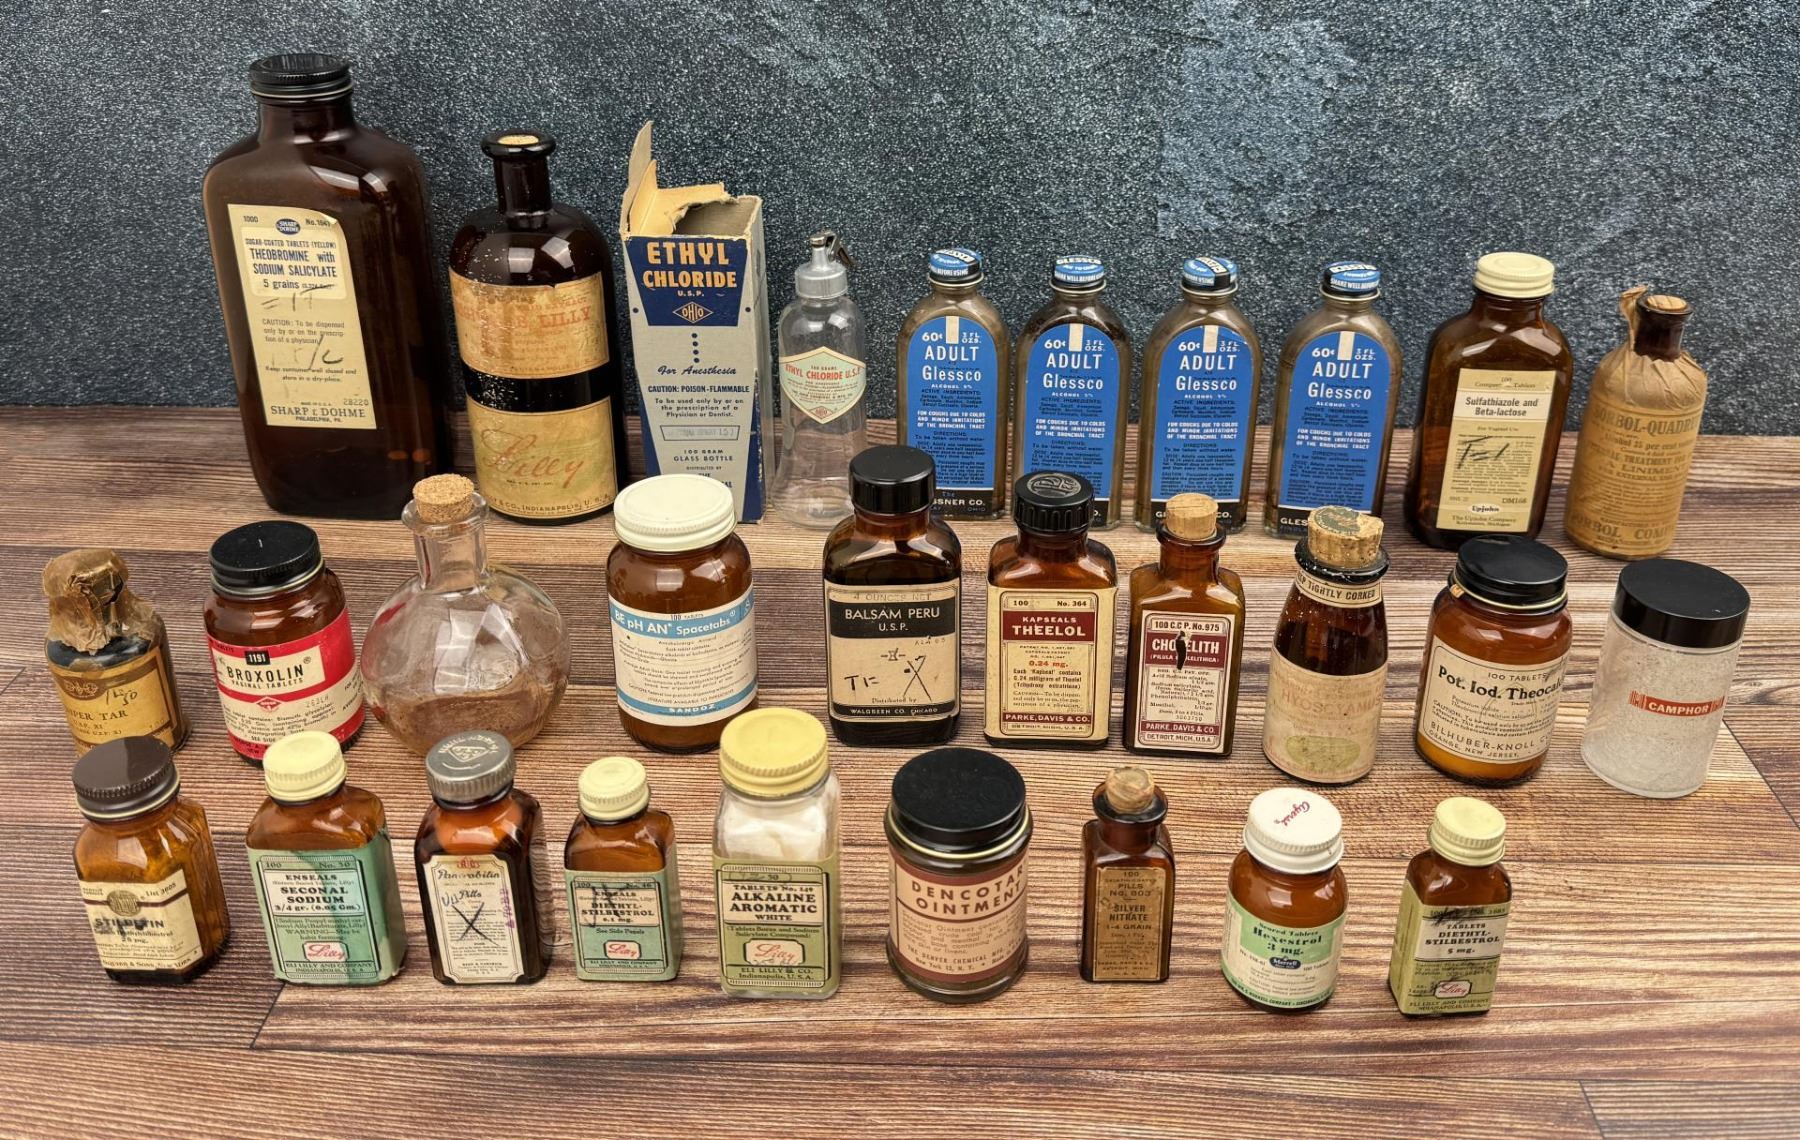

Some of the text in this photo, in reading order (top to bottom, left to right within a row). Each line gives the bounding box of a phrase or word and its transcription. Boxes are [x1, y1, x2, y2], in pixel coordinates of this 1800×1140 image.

[249, 249, 336, 263] THEOBROMINE with
[647, 241, 729, 266] ETHYL
[253, 263, 337, 278] SODIUM SALICYLATE
[263, 279, 269, 288] 5
[273, 280, 300, 291] grains
[643, 270, 738, 289] CHLORIDE
[677, 289, 705, 297] U.S.P.
[682, 305, 704, 319] OHIO
[924, 345, 981, 361] ADULT
[1046, 352, 1104, 369] ADULT
[1179, 354, 1238, 371] ADULT
[658, 364, 737, 376] For Anesthesia
[784, 363, 844, 381] ETHYL CHLORIDE
[921, 365, 982, 381] Glessco
[1311, 361, 1374, 379] ADULT
[1043, 372, 1104, 390] Glessco
[1176, 375, 1237, 391] Glessco
[648, 384, 751, 393] CAUTION: POISON-FLAMMABLE
[1307, 382, 1372, 400] Glessco
[695, 398, 712, 406] only
[713, 398, 723, 406] by
[1465, 396, 1538, 408] Sulfathiazole and
[270, 405, 366, 418] SHARP DOHME
[666, 411, 698, 419] Physician
[1474, 406, 1528, 418] Beta-lactose
[481, 428, 584, 489] Lilly
[968, 499, 986, 507] CO.
[1279, 516, 1309, 527] GLES
[1307, 580, 1376, 601] TIGHTLY CORKED
[865, 592, 933, 602] OUNCES NET
[670, 613, 682, 621] 100
[844, 606, 941, 621] BALSAM PERU
[1022, 615, 1078, 624] KAPSEALS
[613, 609, 626, 626] BE
[627, 621, 644, 633] pH
[676, 618, 731, 637] Spacetabs
[1155, 620, 1169, 630] 100
[1011, 624, 1087, 637] THEELOL
[1151, 638, 1221, 656] CHOELITH
[248, 653, 267, 664] 1191
[1028, 660, 1069, 669] 0.24 mg.
[226, 664, 306, 683] BROXOLIN
[1487, 671, 1549, 682] 100 TABLETS
[231, 678, 304, 690] VAGINAL TABLETS
[1437, 664, 1466, 691] Pot.
[1470, 680, 1502, 700] Iod.
[669, 702, 717, 713] SANDOZ
[1648, 701, 1710, 715] CAMPHOR
[99, 710, 129, 722] TAR
[1005, 714, 1038, 722] PARKE,
[1038, 714, 1064, 722] DAVIS
[1075, 715, 1091, 723] CO.
[1145, 722, 1172, 731] PARKE,
[1172, 724, 1195, 733] DAVIS
[1203, 726, 1217, 734] CO.
[1430, 720, 1536, 751] BILHUBER-KNOLL
[1464, 746, 1483, 756] NEW
[265, 861, 337, 870] 100 No.
[285, 873, 338, 881] ENSEALS
[733, 884, 798, 893] TABLETS No.
[911, 865, 1024, 902] DENCOTAR
[1116, 882, 1145, 890] PILLS
[280, 885, 349, 895] SECONAL
[1108, 890, 1128, 898] No.
[286, 895, 346, 905] SODIUM
[730, 891, 817, 904] ALKALINE
[915, 879, 1022, 915] OINTMENT
[274, 903, 294, 913] 3/4
[591, 902, 643, 910] DIETHYL-
[729, 902, 818, 914] AROMATIC
[1113, 904, 1147, 914] SILVER
[580, 909, 656, 917] STILBESTROL
[754, 913, 794, 922] WHITE
[1108, 913, 1149, 922] NITRATE
[1122, 923, 1153, 931] GRAIN
[1446, 922, 1487, 930] TABLETS
[1252, 925, 1323, 947] Hexestrol
[1424, 935, 1502, 946] STILBESTROL
[1438, 930, 1493, 939] DIETHYL-
[307, 943, 347, 961] Lilly
[608, 943, 638, 958] Lilly
[754, 942, 796, 960] Lilly
[907, 944, 988, 965] THE DENVER CHEMICAL
[1266, 941, 1305, 957] 3 mg.
[1446, 947, 1477, 955] 5 mg.
[740, 966, 757, 974] ELI
[758, 966, 783, 974] LILLY
[928, 961, 942, 971] York
[738, 973, 785, 981] Indianapolis,
[1438, 983, 1469, 995] Lilly
